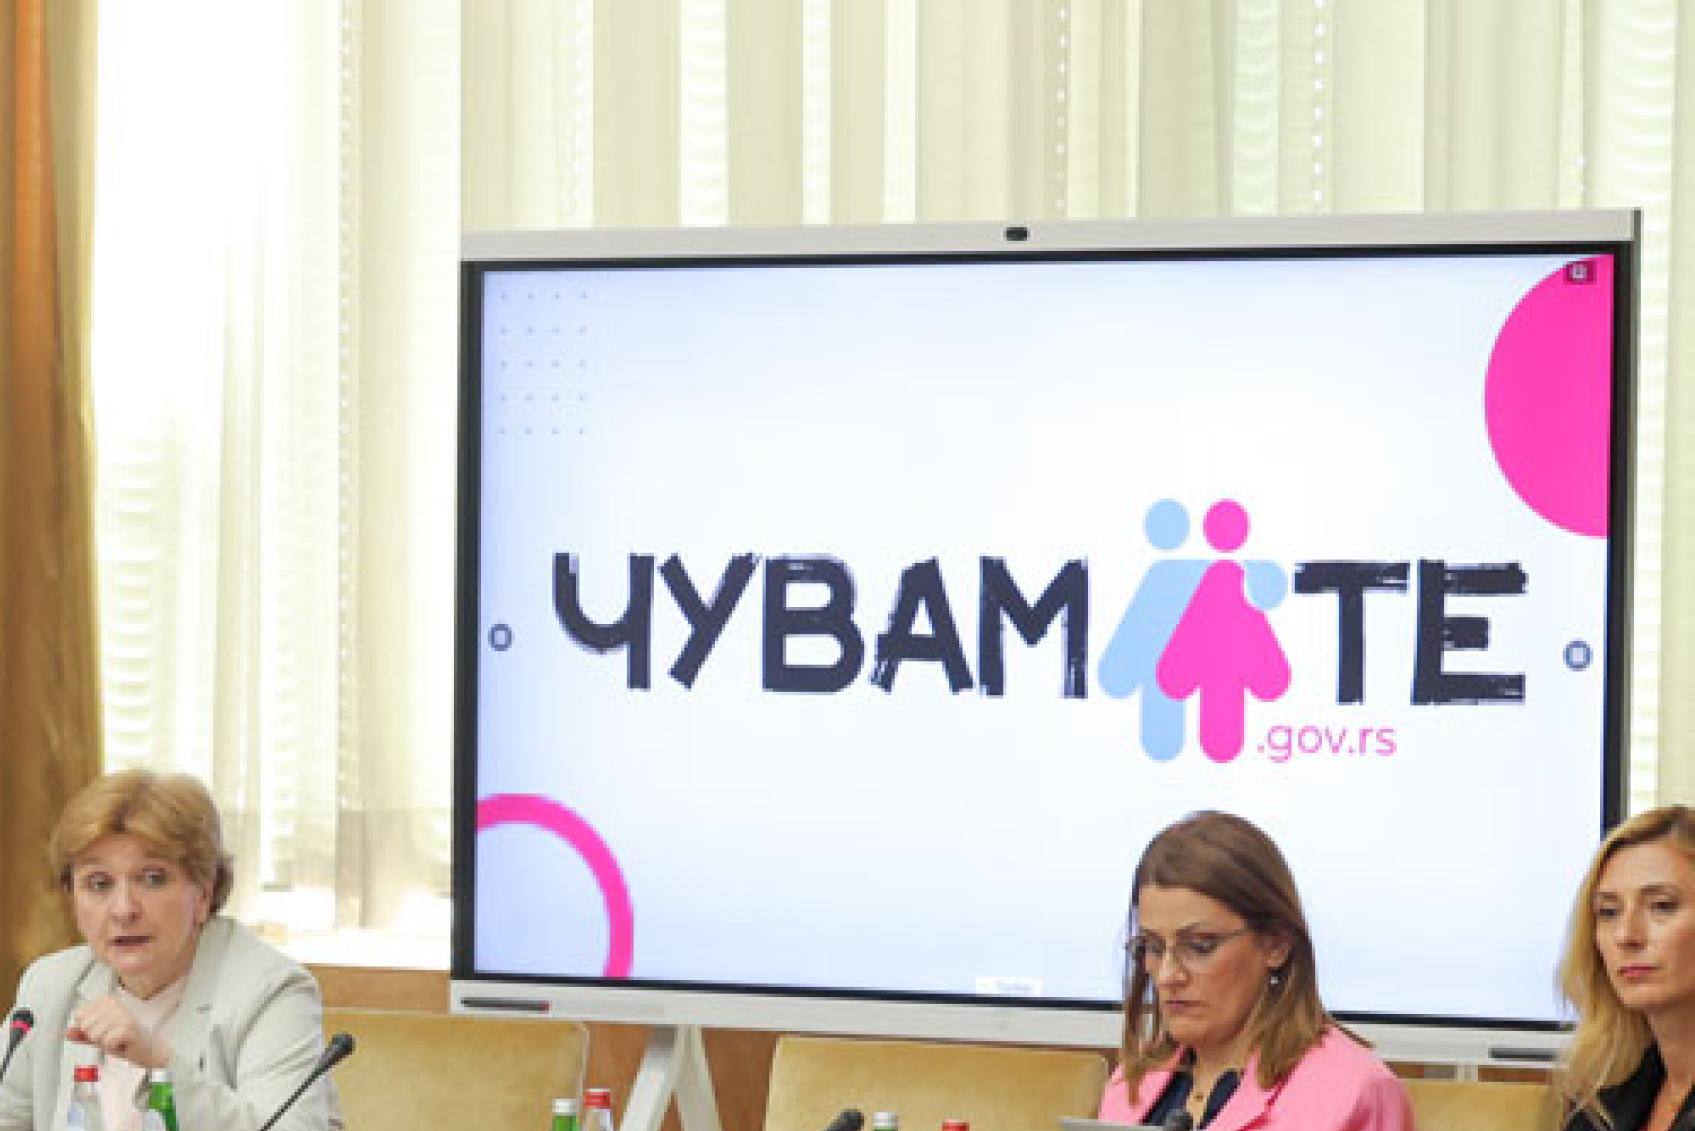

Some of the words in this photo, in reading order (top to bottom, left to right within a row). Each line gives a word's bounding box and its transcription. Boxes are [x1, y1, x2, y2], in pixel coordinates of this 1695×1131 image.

[553, 551, 1089, 699] ЧУВАМ
[1293, 560, 1528, 706] ТЕ
[1257, 724, 1397, 763] .gov.rs
